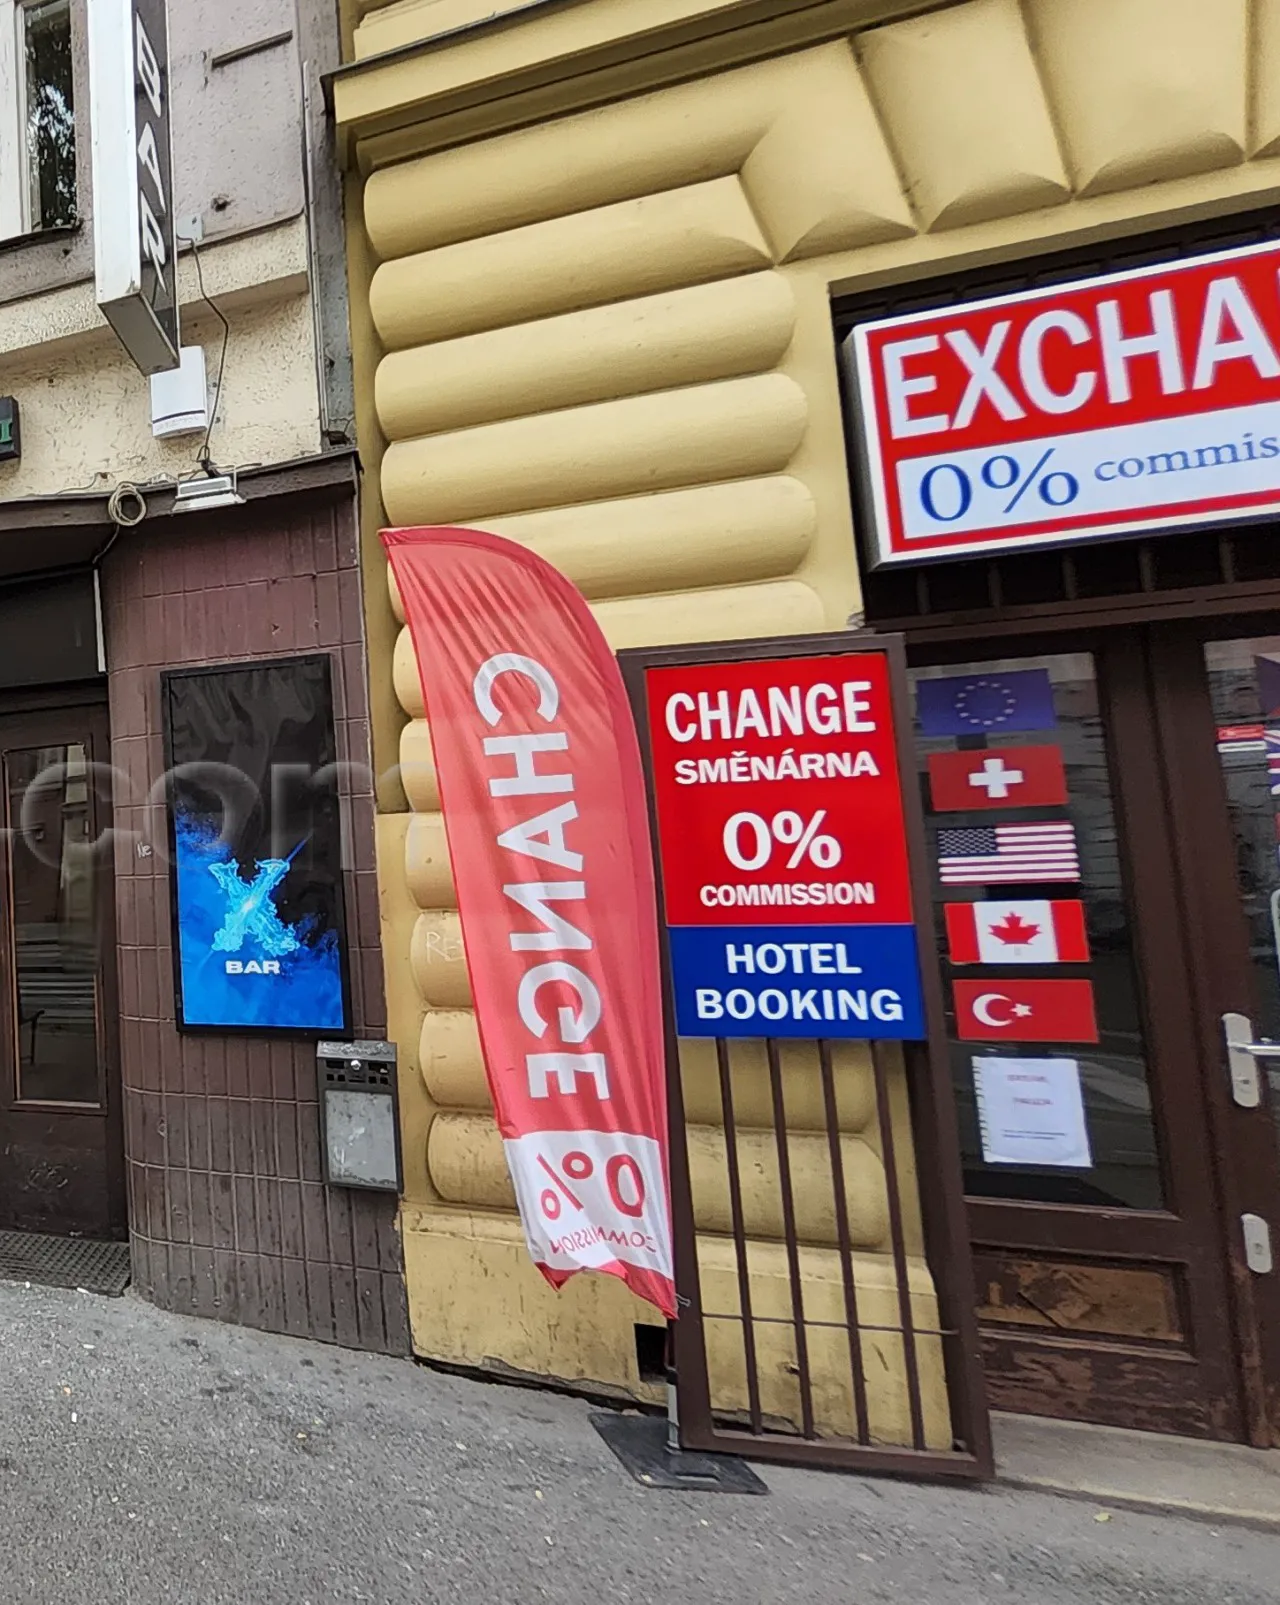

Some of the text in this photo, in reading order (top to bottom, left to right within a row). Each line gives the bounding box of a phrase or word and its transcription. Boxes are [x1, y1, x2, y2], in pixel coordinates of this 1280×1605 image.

[135, 9, 168, 298] BAR
[881, 267, 1280, 440] EXCHA
[919, 447, 1080, 522] 0%
[665, 680, 876, 743] CHANGE
[674, 748, 880, 785] SMĚNÁRNA
[722, 809, 842, 872] 0%
[699, 882, 876, 907] COMMISSION
[225, 960, 281, 975] BAR
[725, 942, 863, 975] HOTEL
[695, 988, 904, 1022] BOOKING
